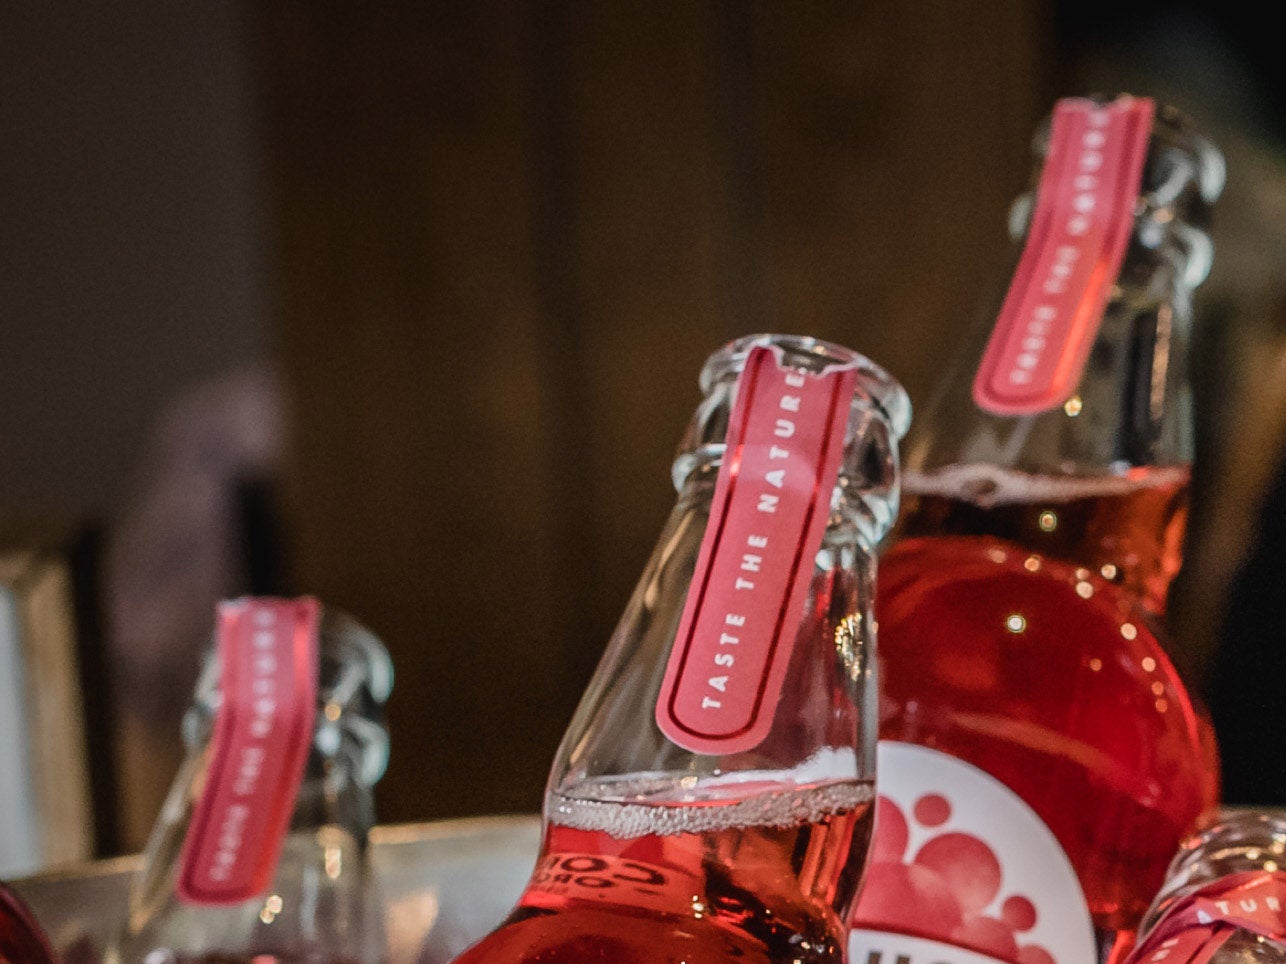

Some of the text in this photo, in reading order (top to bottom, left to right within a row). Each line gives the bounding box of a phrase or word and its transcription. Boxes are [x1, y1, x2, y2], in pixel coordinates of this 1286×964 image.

[702, 370, 806, 709] TASTE THE NATURE
